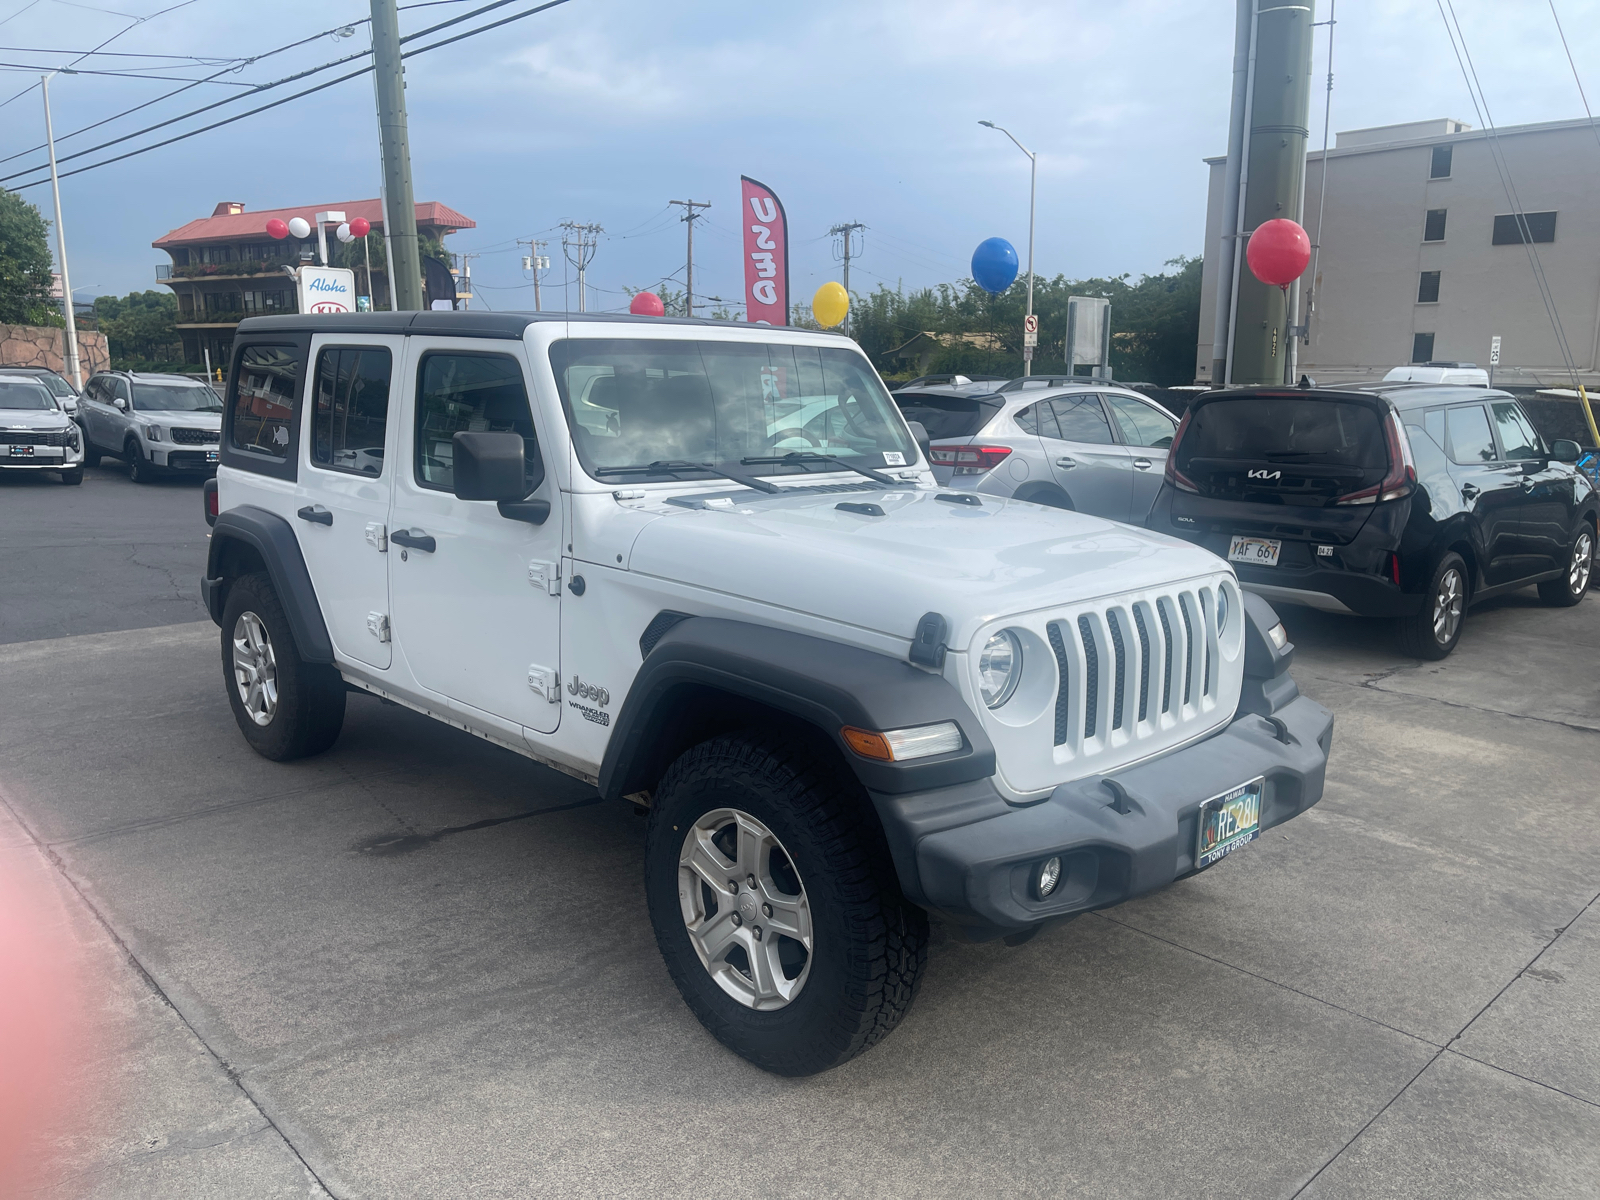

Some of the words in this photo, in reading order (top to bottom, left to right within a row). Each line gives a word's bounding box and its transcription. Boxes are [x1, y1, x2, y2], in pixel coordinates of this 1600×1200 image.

[309, 277, 348, 293] Aloha
[1491, 350, 1499, 362] 25
[1247, 469, 1282, 480] KIA
[1233, 541, 1253, 557] YAF
[1257, 544, 1279, 560] 667
[567, 674, 610, 708] Jeep
[568, 700, 610, 719] WRANGLER
[1208, 848, 1226, 863] TONY
[1231, 833, 1253, 852] GROUP
